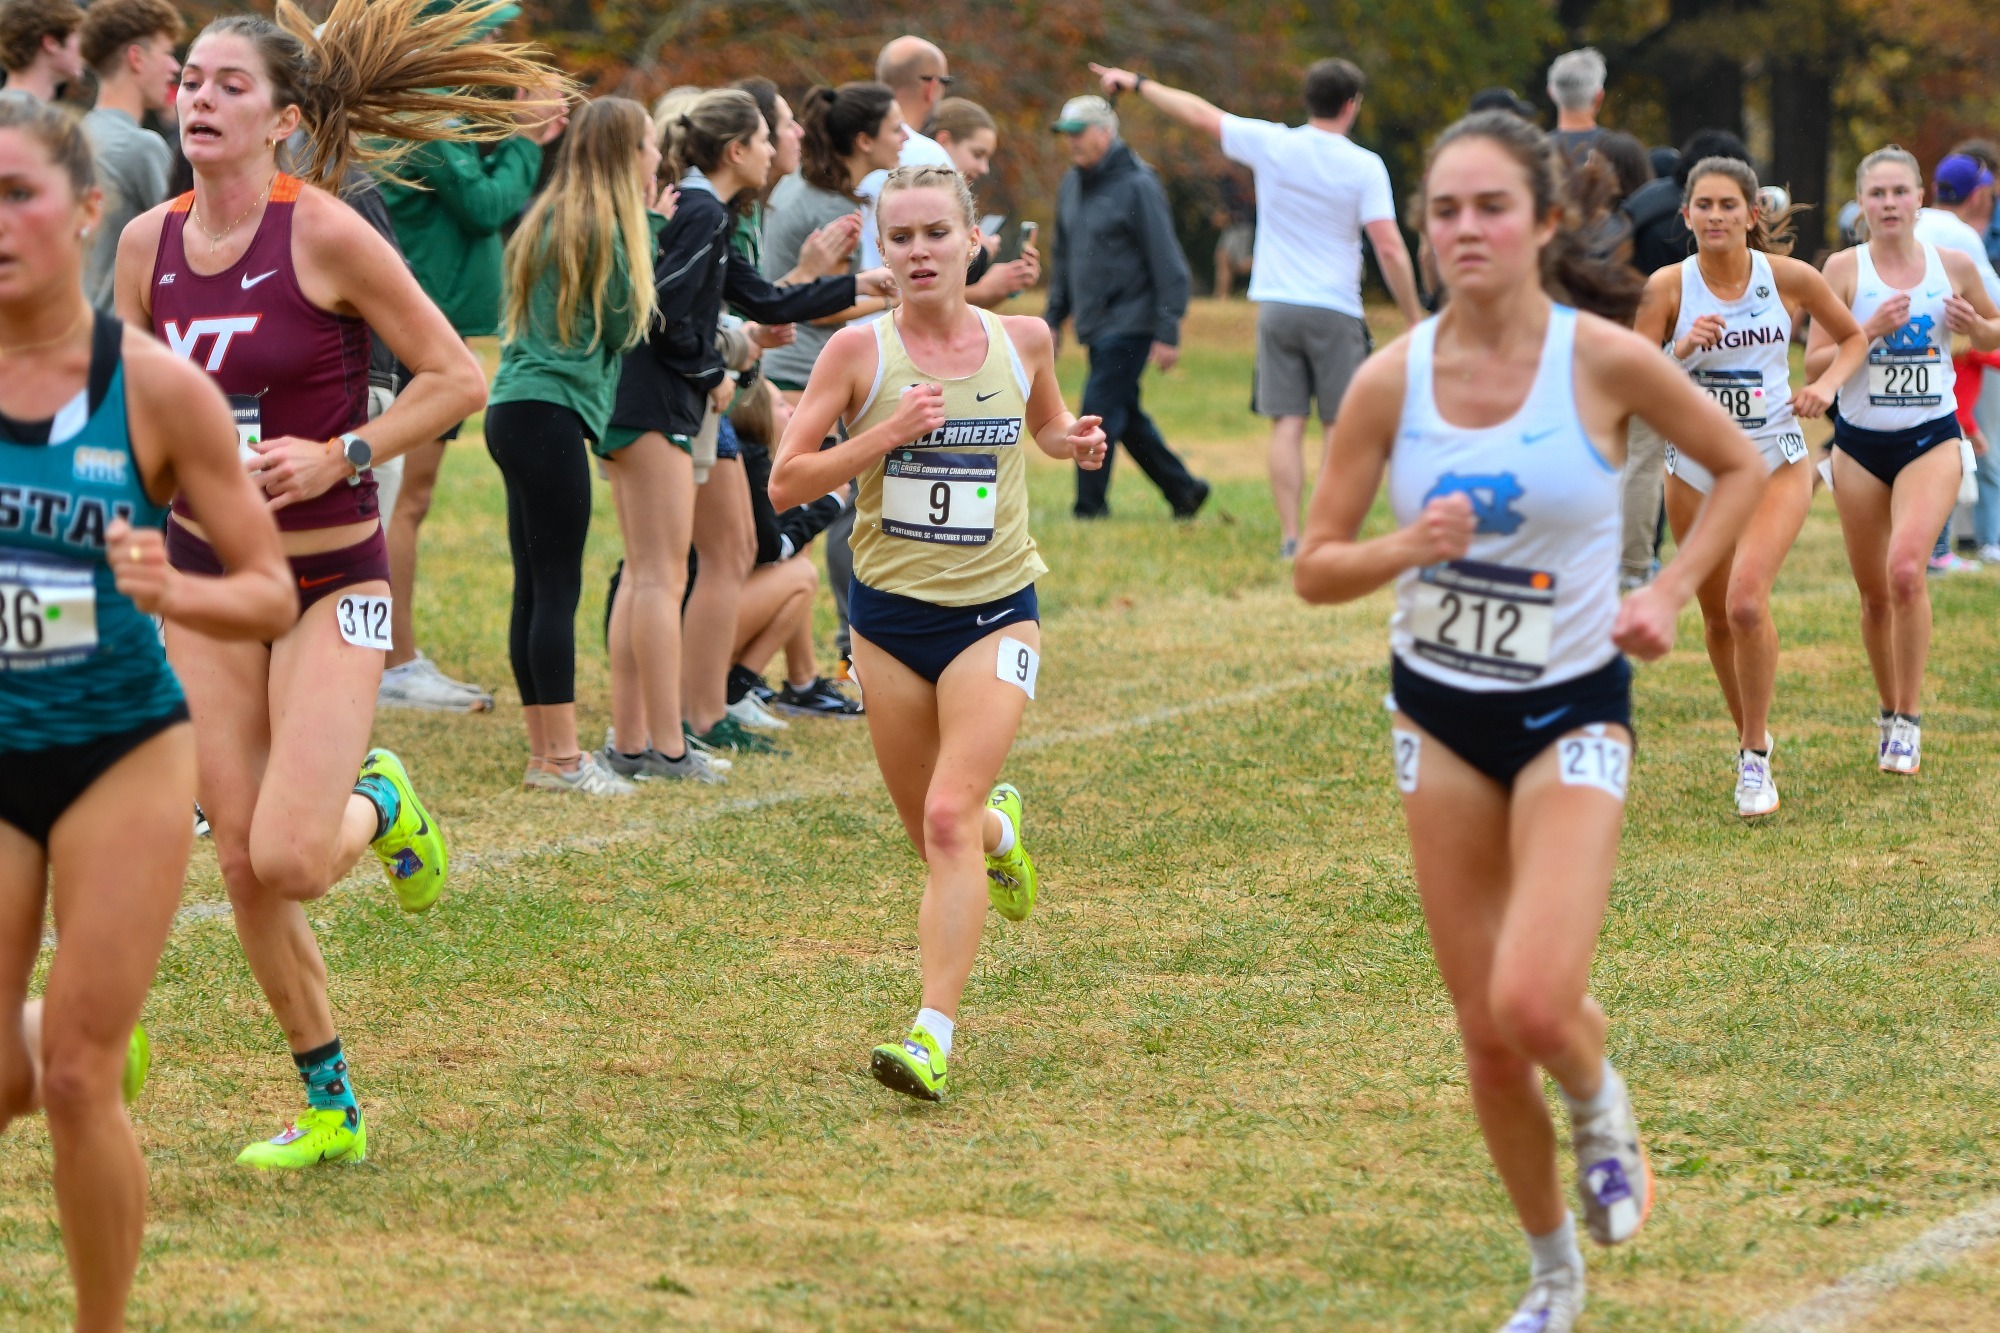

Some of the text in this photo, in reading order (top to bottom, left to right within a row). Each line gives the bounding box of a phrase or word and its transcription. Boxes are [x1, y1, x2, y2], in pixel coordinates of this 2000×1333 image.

[159, 273, 176, 285] ACC
[163, 314, 262, 373] VT
[1701, 326, 1785, 352] GINIA
[1884, 366, 1929, 394] 220
[1706, 388, 1750, 417] 98
[904, 420, 1020, 446] CANEERS
[900, 464, 996, 476] CROSS COUNTRY CHAMPIONSHIPS
[0, 485, 135, 547] STA
[928, 481, 951, 525] 9
[934, 533, 960, 541] NOVEMBER
[960, 534, 973, 542] 10TH
[339, 598, 388, 641] 312
[1437, 591, 1522, 658] 212
[1016, 647, 1029, 682] 9
[1564, 740, 1624, 788] 212
